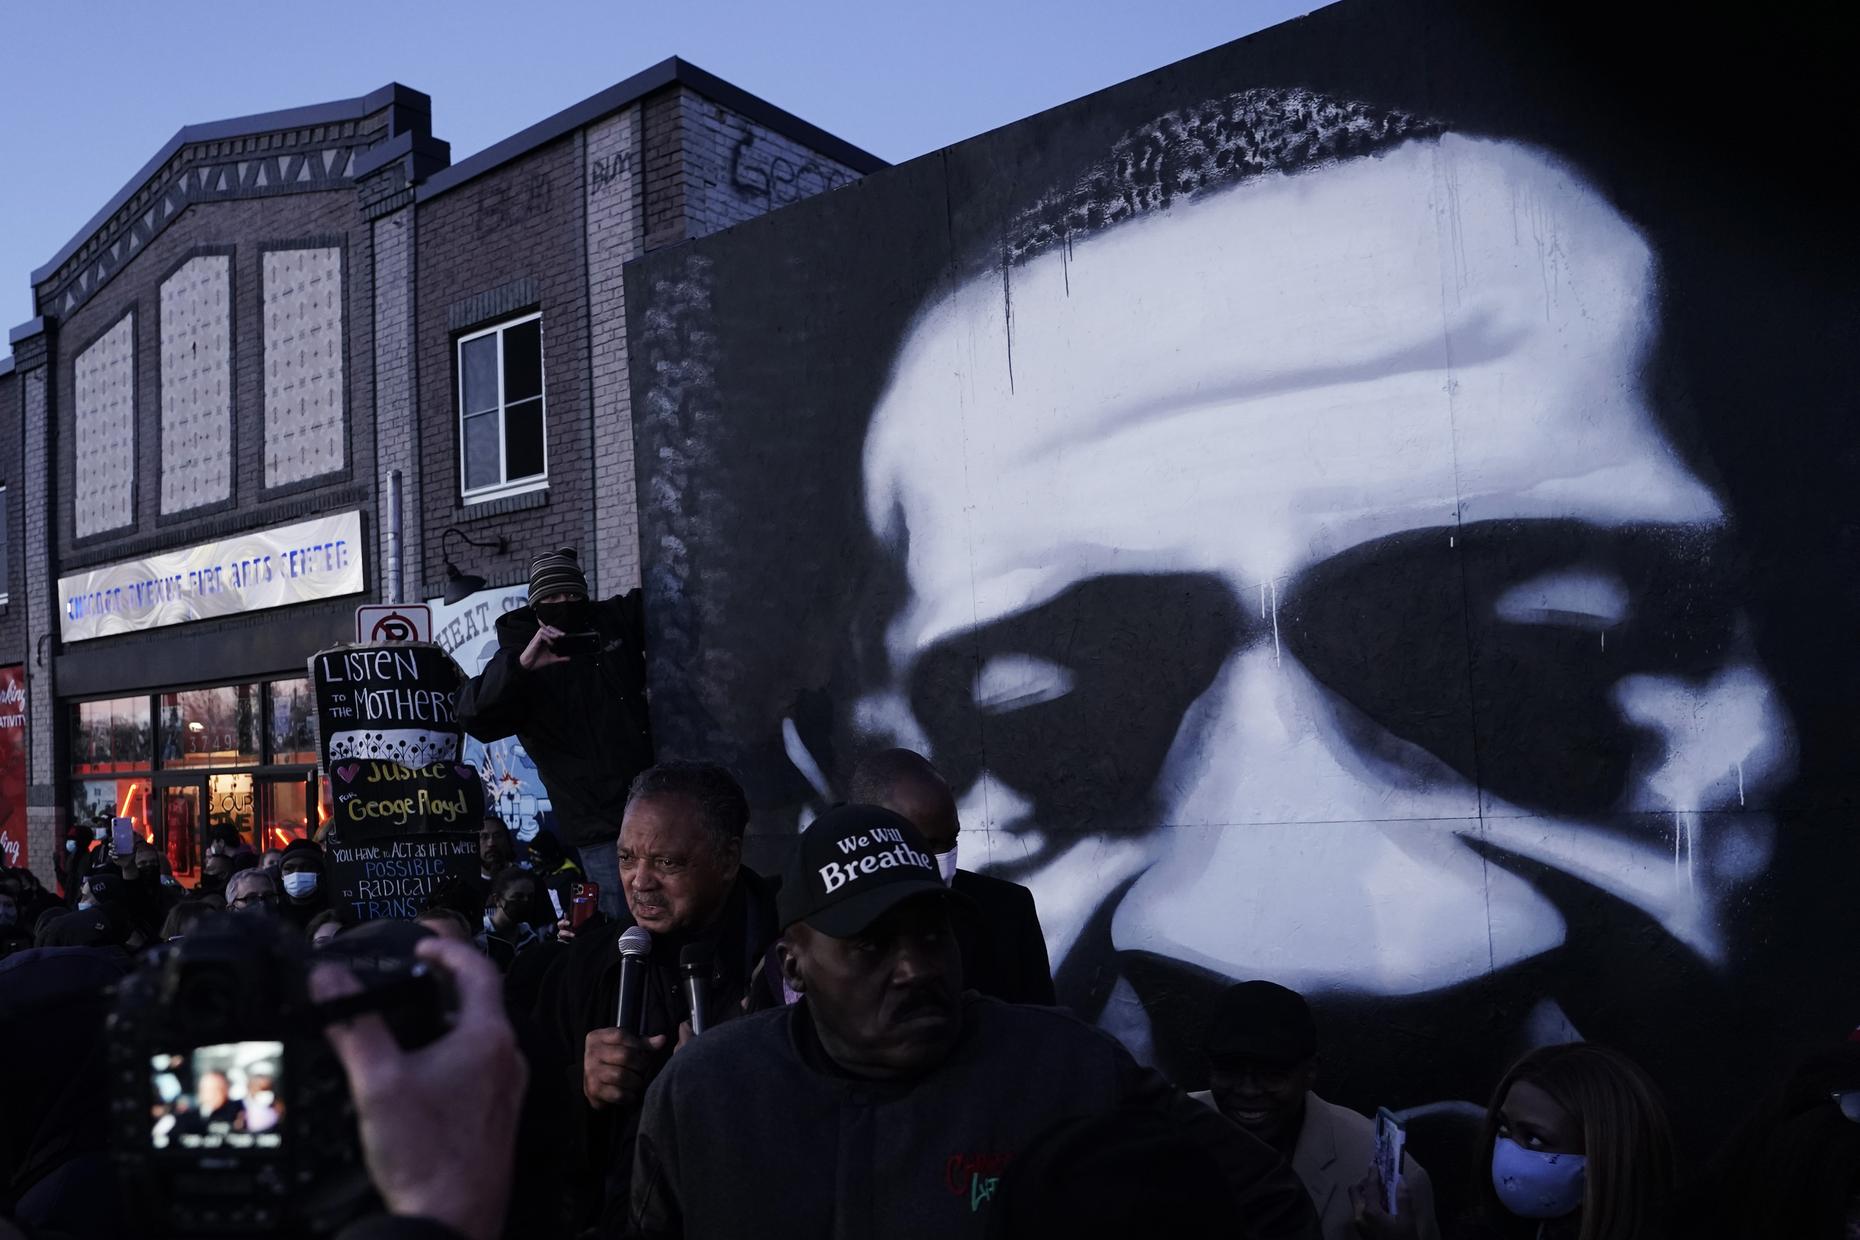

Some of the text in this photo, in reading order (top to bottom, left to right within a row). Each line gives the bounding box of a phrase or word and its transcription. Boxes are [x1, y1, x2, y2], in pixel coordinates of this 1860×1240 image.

[836, 827, 905, 855] We Will
[818, 843, 933, 894] Breathe
